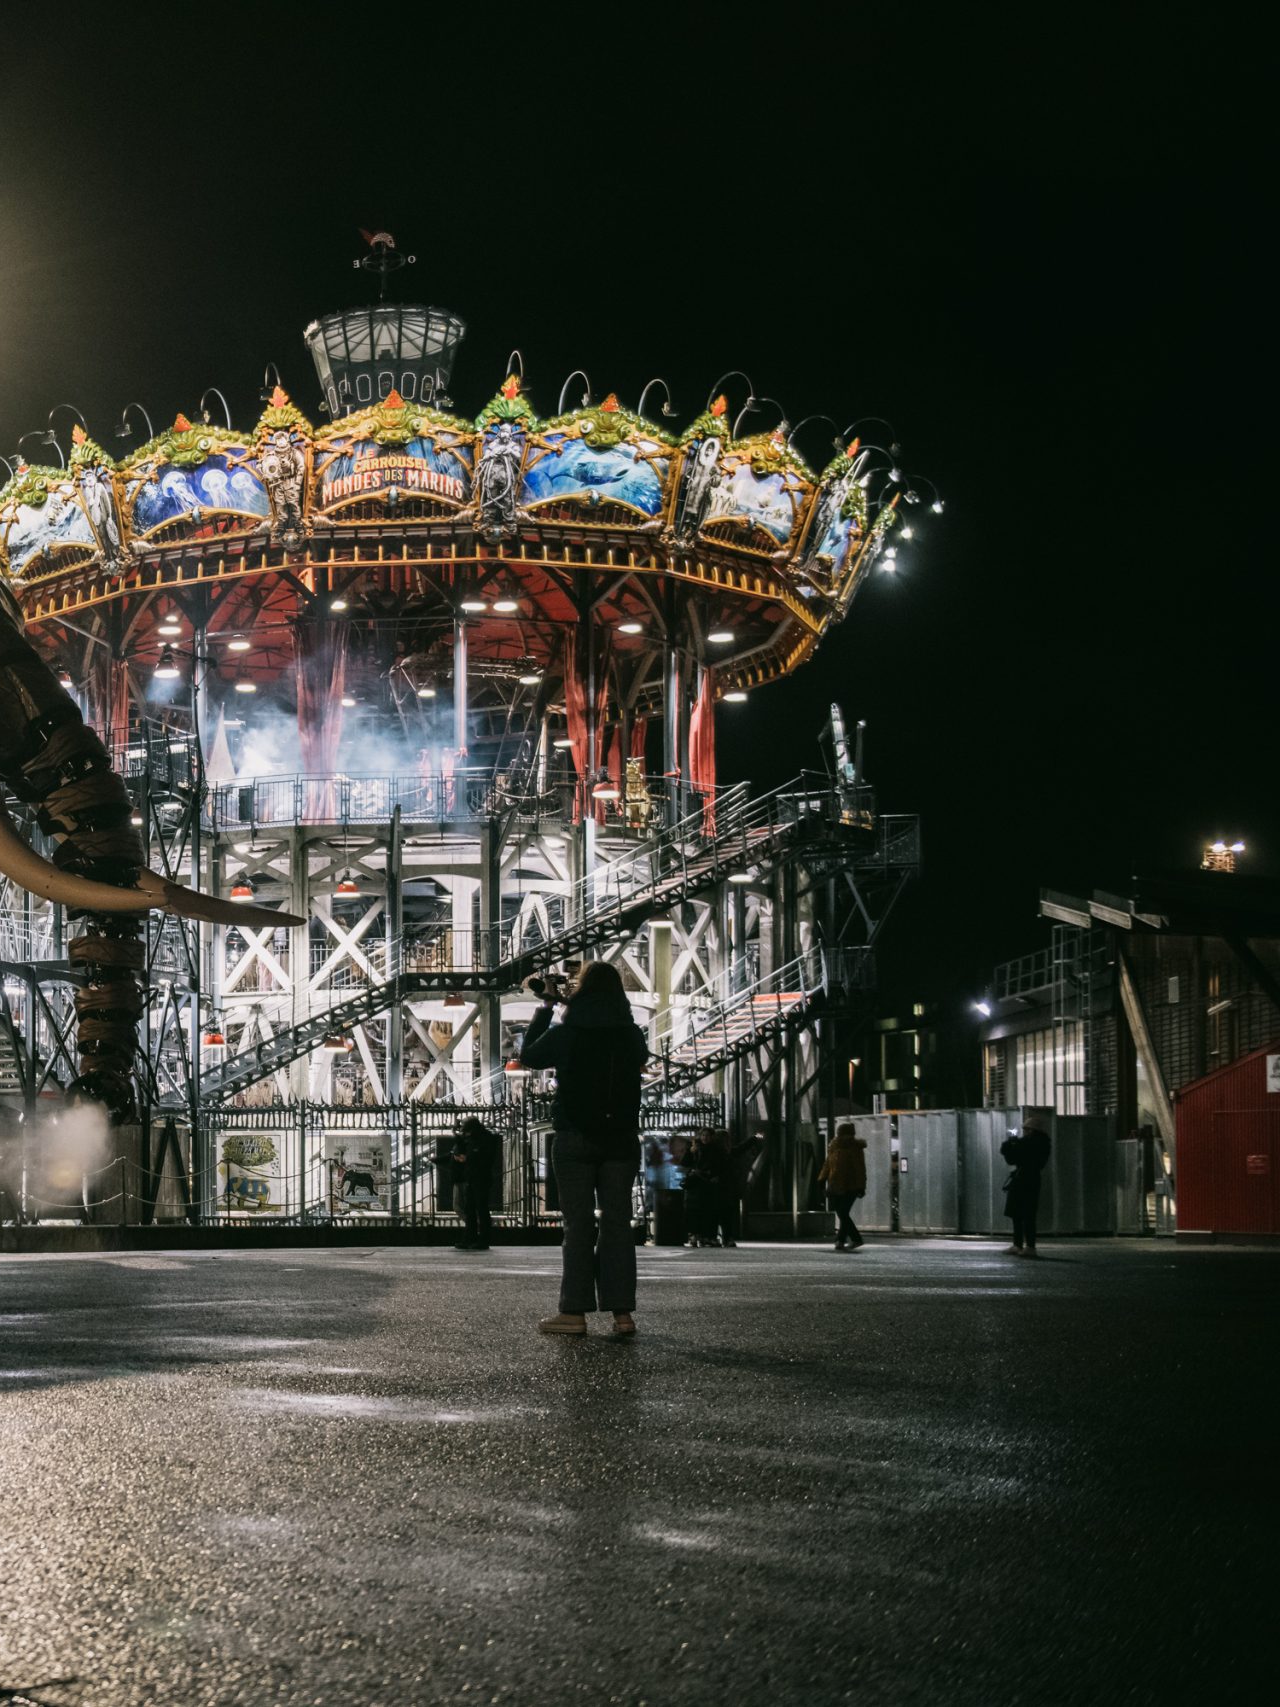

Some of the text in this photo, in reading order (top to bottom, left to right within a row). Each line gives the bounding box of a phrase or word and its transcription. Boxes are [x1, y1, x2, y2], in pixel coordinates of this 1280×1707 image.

[356, 448, 375, 460] LE
[353, 456, 432, 473] CARROUSEL
[322, 469, 464, 506] MONDES DES MARINS
[637, 828, 653, 839] LA
